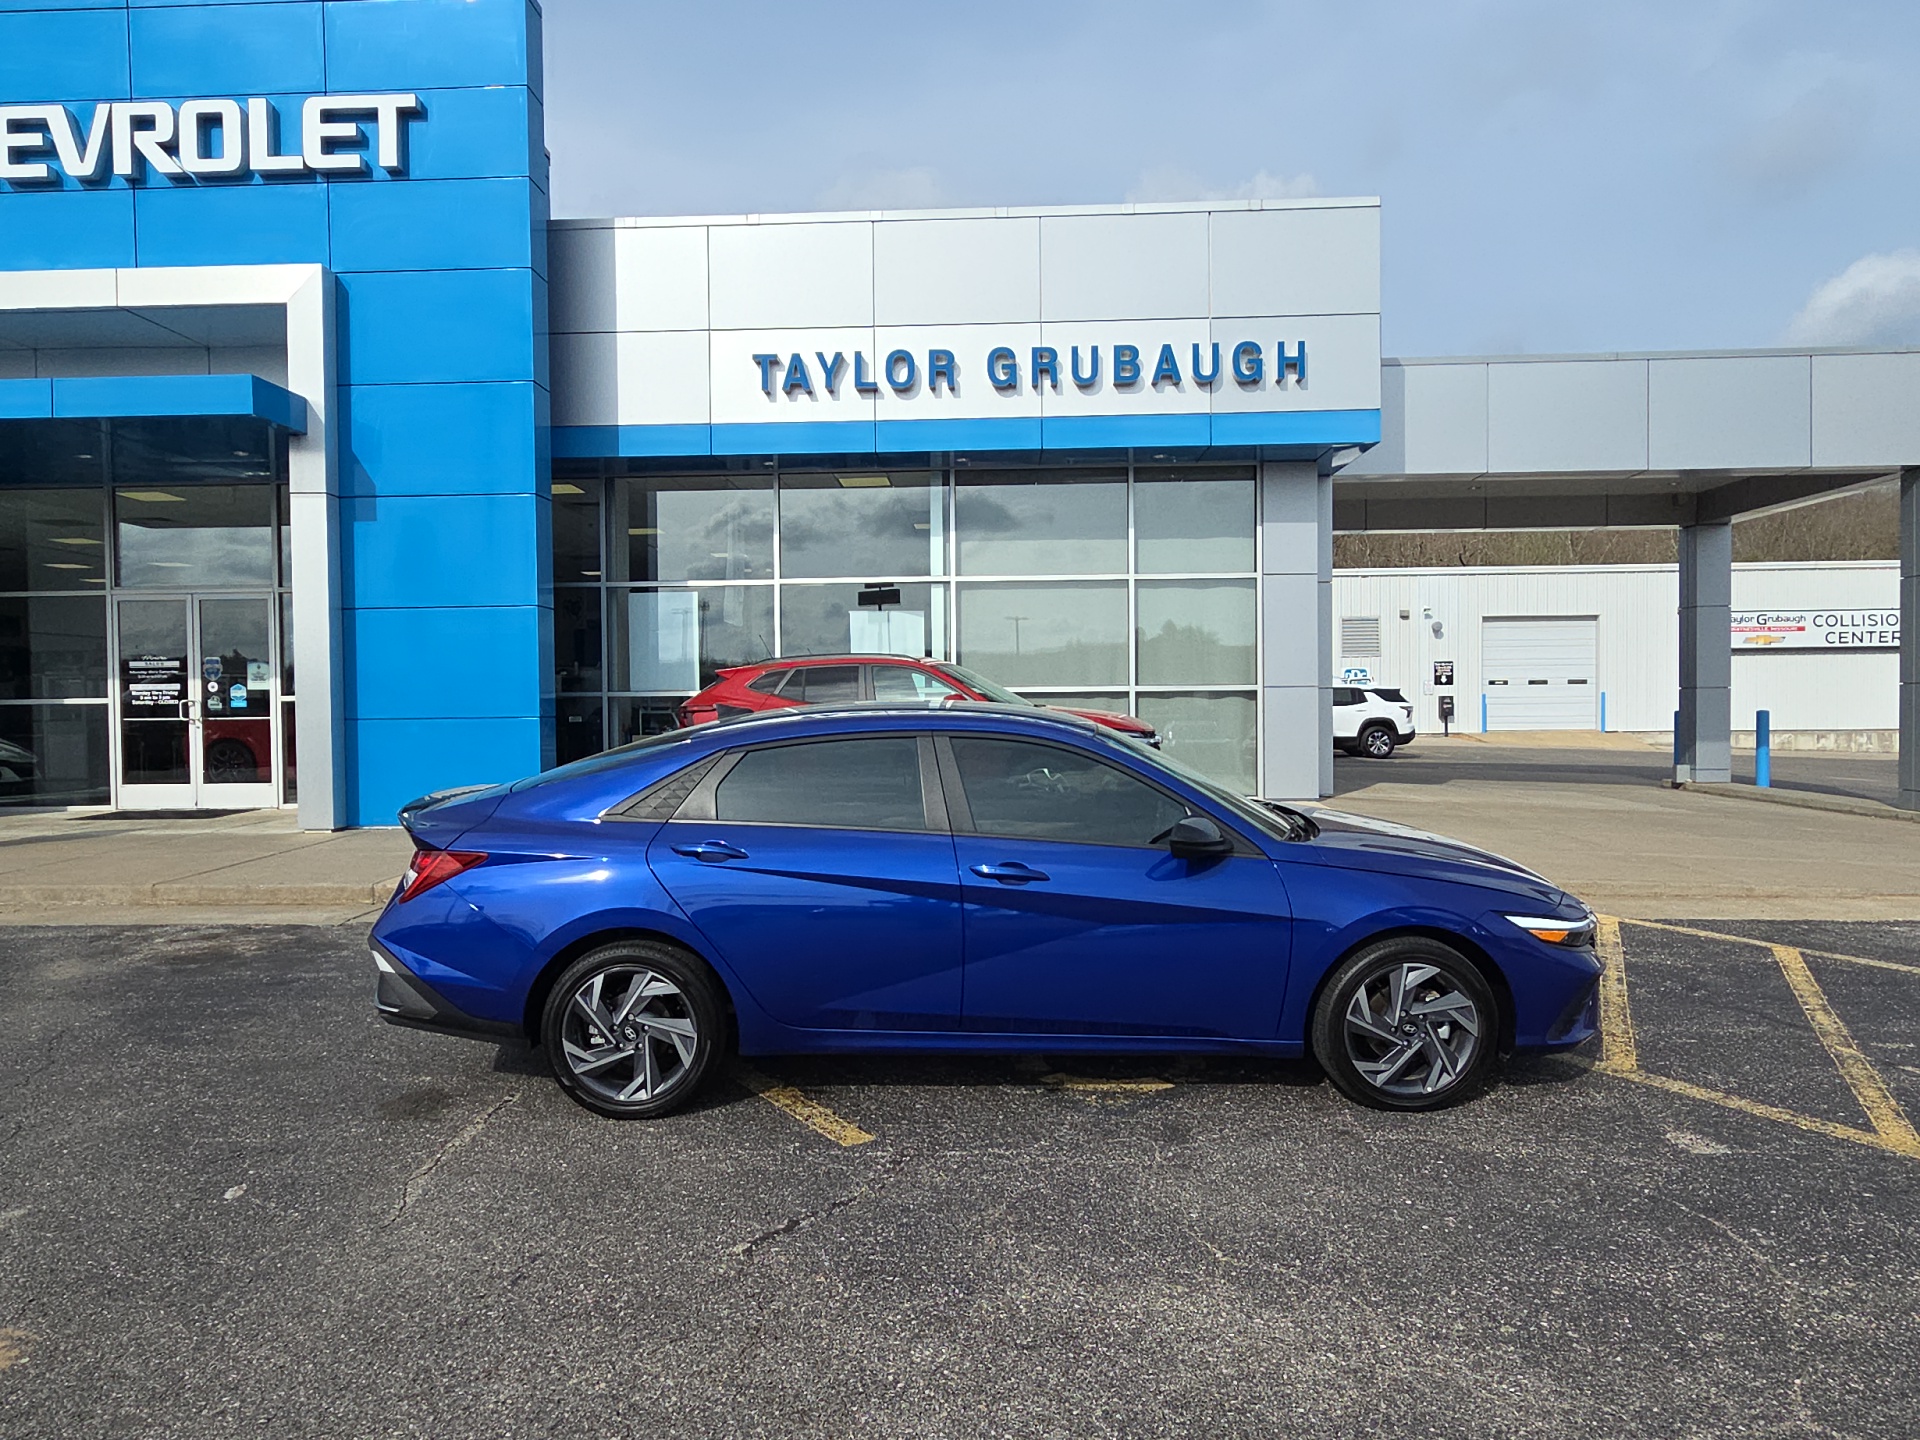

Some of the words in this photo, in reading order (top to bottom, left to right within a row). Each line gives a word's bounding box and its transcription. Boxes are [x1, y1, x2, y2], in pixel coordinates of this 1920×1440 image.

[752, 349, 955, 395] TAYLOR
[987, 341, 1306, 388] GRUBAUGH
[1730, 613, 1755, 625] aylor
[1757, 613, 1806, 625] Grubaugh
[1812, 614, 1899, 628] COLLISIO
